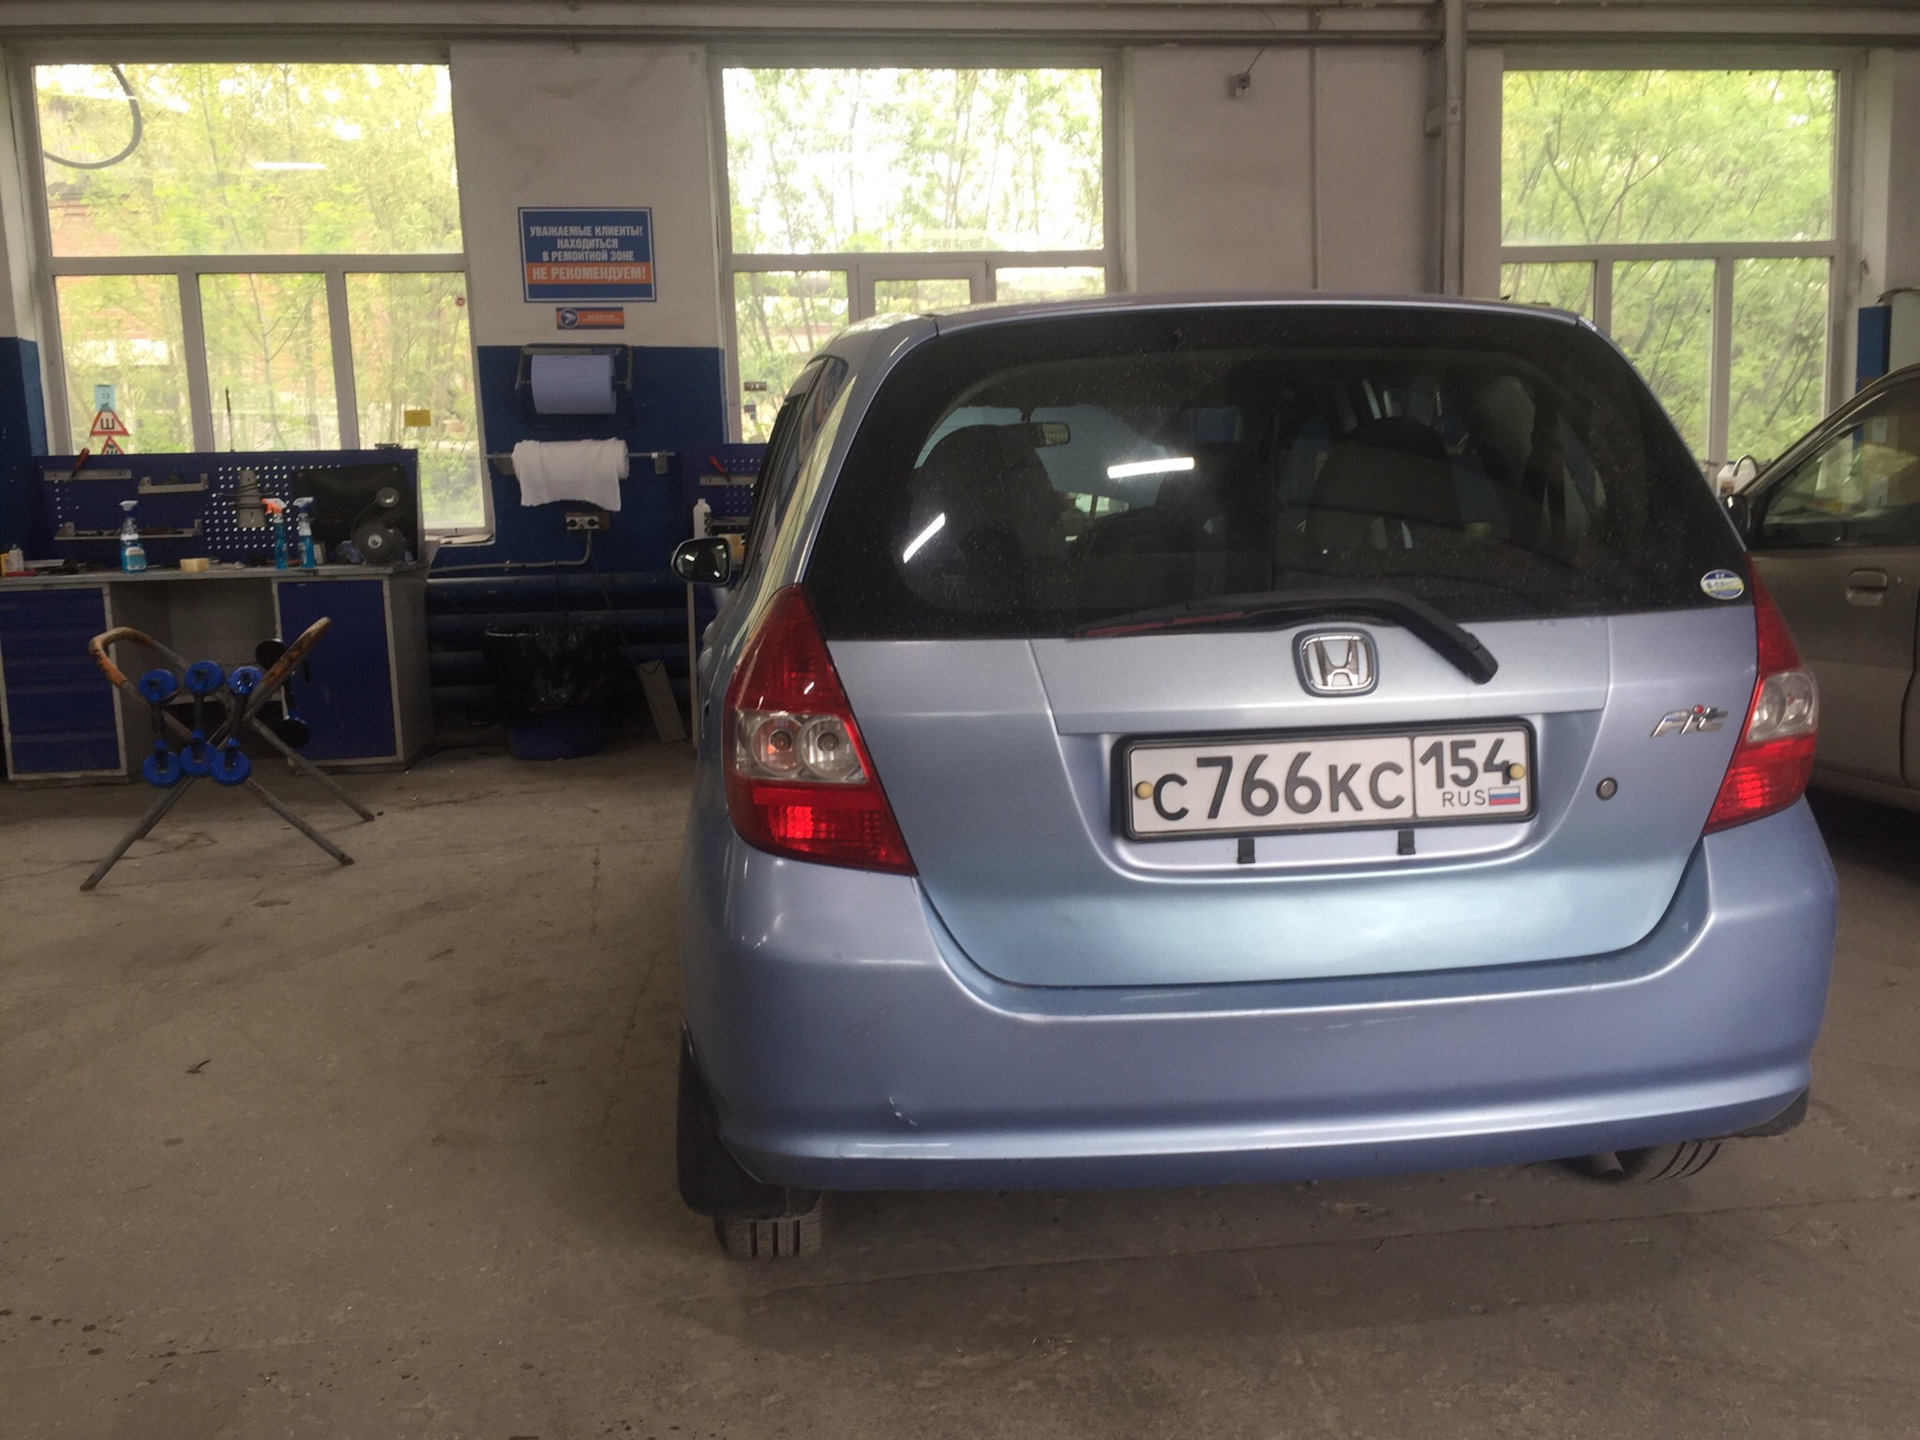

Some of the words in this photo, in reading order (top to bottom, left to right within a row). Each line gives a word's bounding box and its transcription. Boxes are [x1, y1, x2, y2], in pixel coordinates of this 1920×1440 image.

[530, 226, 592, 237] УВАЖАЕМЫЕ
[594, 226, 643, 236] КЛИЕНТЫ!
[557, 238, 618, 249] НАХОДИТЬСЯ
[542, 252, 549, 261] В
[551, 250, 608, 261] РЕМОНТНОЙ
[610, 251, 635, 261] ЗОНЕ
[532, 267, 548, 280] НЕ
[552, 267, 645, 281] РЕКОМЕНДУЕМ!
[101, 418, 115, 429] Ш
[1419, 738, 1511, 789] 154
[1442, 790, 1486, 808] RUS
